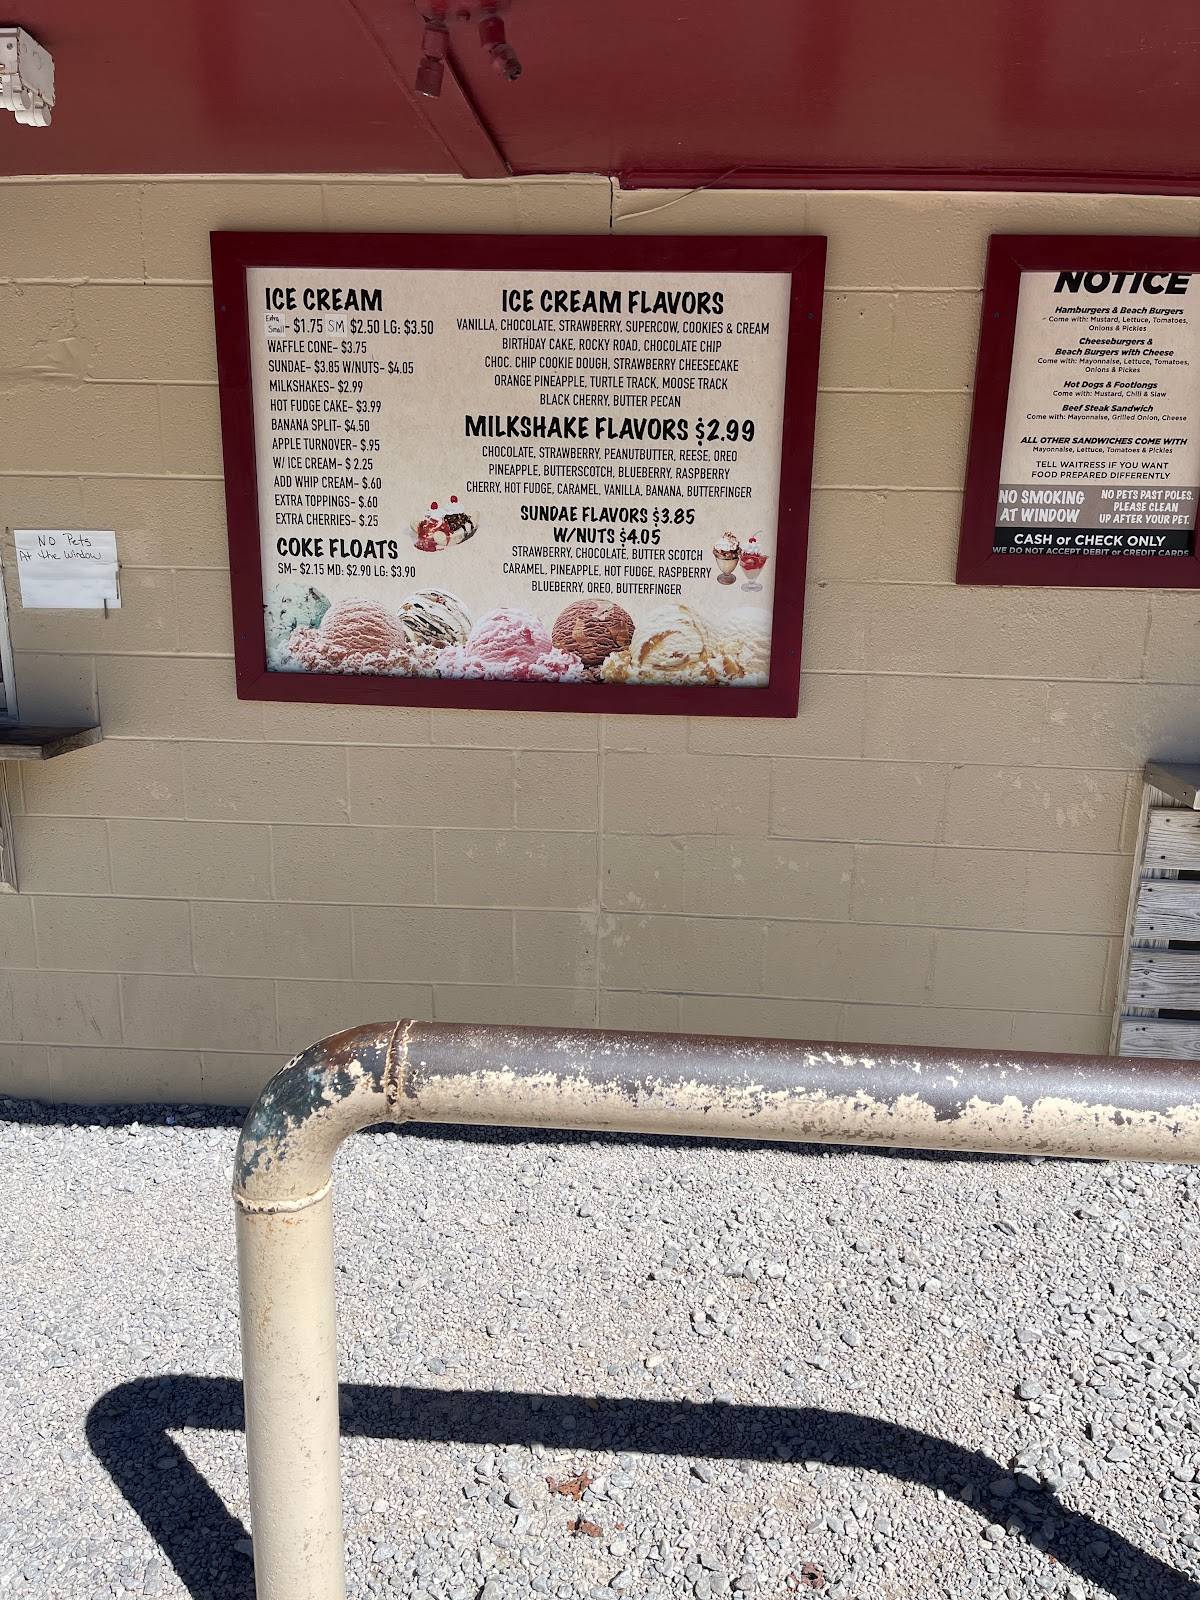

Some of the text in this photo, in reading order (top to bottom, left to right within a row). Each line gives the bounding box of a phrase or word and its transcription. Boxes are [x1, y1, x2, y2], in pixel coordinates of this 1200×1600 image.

[1054, 272, 1192, 294] NOTICE
[265, 288, 382, 311] ICE CREAM
[502, 289, 724, 314] ICE CREAM FLAVORS
[294, 318, 322, 333] $1.75
[328, 320, 344, 332] SM
[350, 320, 434, 334] $2.50 LG: $3.50
[457, 319, 769, 334] VANILLA, CHOCOLATE, STRAWBERRY, SUPERCOW, COOKIES & CREAM
[268, 340, 366, 354] WAFFLE CONE- $3.75
[268, 360, 414, 374] SUNDAE- $3.85 W/NUTS- $4.05
[485, 356, 739, 371] CHOC. CHIP COOKIE DOUGH, STRAWBERRY CHEESECAKE
[270, 380, 363, 393] MILKSHAKES- $2.99
[494, 375, 728, 390] ORANGE PINEAPPLE, TURTLE TRACK, MOOSE TRACK
[270, 400, 381, 413] HOT FUDGE CAKE- $3.99
[540, 394, 681, 407] BLACK CHERRY, BUTTER PECAN
[272, 419, 369, 432] BANANA SPLIT- $4.50
[465, 415, 754, 446] MILKSHAKE FLAVORS $2.99
[272, 438, 380, 452] APPLE TURNOVER- $.95
[482, 445, 737, 462] CHOCOLATE, STRAWBERRY, PEANUTBUTTER, REESE, OREO
[274, 476, 381, 489] ADD WHIP CREAM- $.60
[275, 495, 378, 508] EXTRA TOPPINGS- $.60
[999, 490, 1085, 504] NO SMOKING
[1101, 490, 1194, 500] NO PETS PAST POLES.
[1114, 502, 1178, 512] PLEASE CLEAN
[276, 513, 378, 527] EXTRA CHERRIES- $.25
[520, 506, 695, 526] SUNDAE FLAVORS $3.85
[1000, 508, 1080, 522] AT WINDOW
[1100, 514, 1190, 524] UP AFTER YOUR PET.
[38, 533, 91, 546] NO Pets
[554, 528, 660, 547] W/NUTS $4.05
[1014, 534, 1166, 546] CASH or CHECK ONLY
[277, 538, 398, 559] COKE FLOATS
[278, 563, 415, 577] SM- $2.15 MD: $2.90 LG: $3.90
